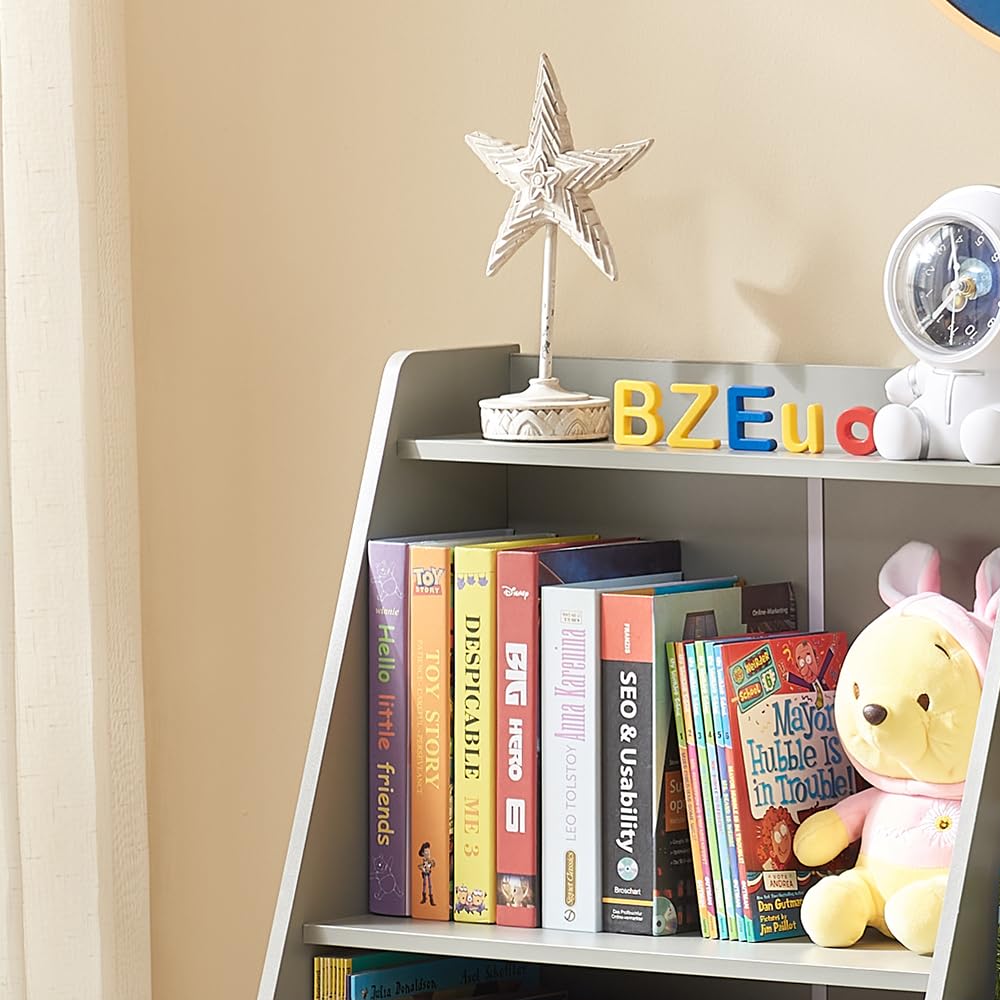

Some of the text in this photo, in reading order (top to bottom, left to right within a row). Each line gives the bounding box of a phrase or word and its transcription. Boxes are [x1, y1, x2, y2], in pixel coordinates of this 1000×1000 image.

[412, 567, 446, 588] TOY
[415, 586, 441, 595] STORY
[554, 629, 586, 698] Karenina
[765, 674, 772, 688] 6
[376, 624, 396, 847] Hello little friends
[424, 649, 441, 791] TOY STORY
[463, 615, 481, 857] DESPICABLE ME 3
[505, 642, 528, 834] BIG HERO 6
[554, 703, 586, 742] Anna
[772, 698, 835, 740] Mayor
[615, 670, 638, 854] SEO & Usability
[746, 737, 817, 775] Hubble
[565, 744, 577, 841] LEO TOLSTOY
[753, 779, 774, 807] in
[775, 765, 856, 805] Trouble!
[758, 900, 773, 912] Dan
[760, 923, 773, 936] Jim
